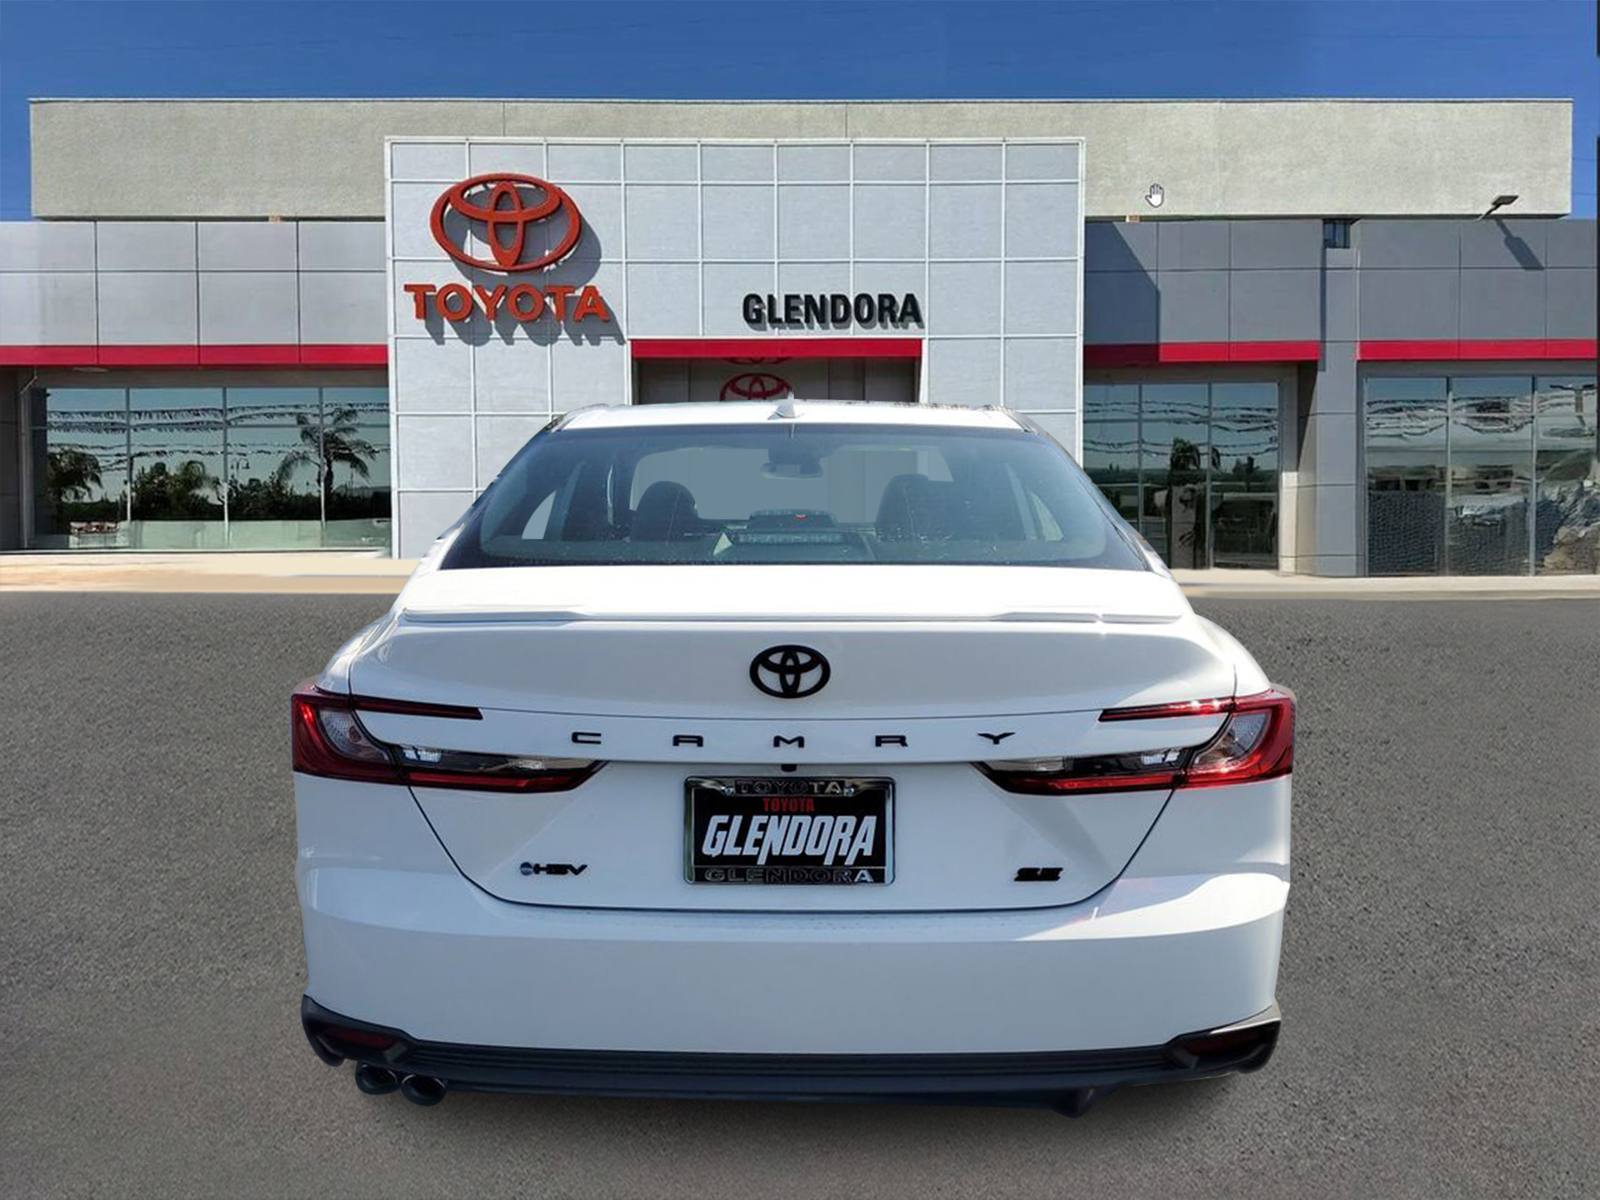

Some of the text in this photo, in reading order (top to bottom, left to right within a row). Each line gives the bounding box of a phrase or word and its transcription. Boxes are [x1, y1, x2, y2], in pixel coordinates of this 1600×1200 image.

[404, 283, 611, 323] TOYOTA
[742, 293, 922, 325] GLENDORA
[571, 731, 1015, 748] CAMRY
[736, 779, 842, 794] TOYOTA
[763, 797, 814, 812] TOYOTA
[702, 815, 877, 865] GLENDORA
[704, 869, 874, 883] GLENDORA
